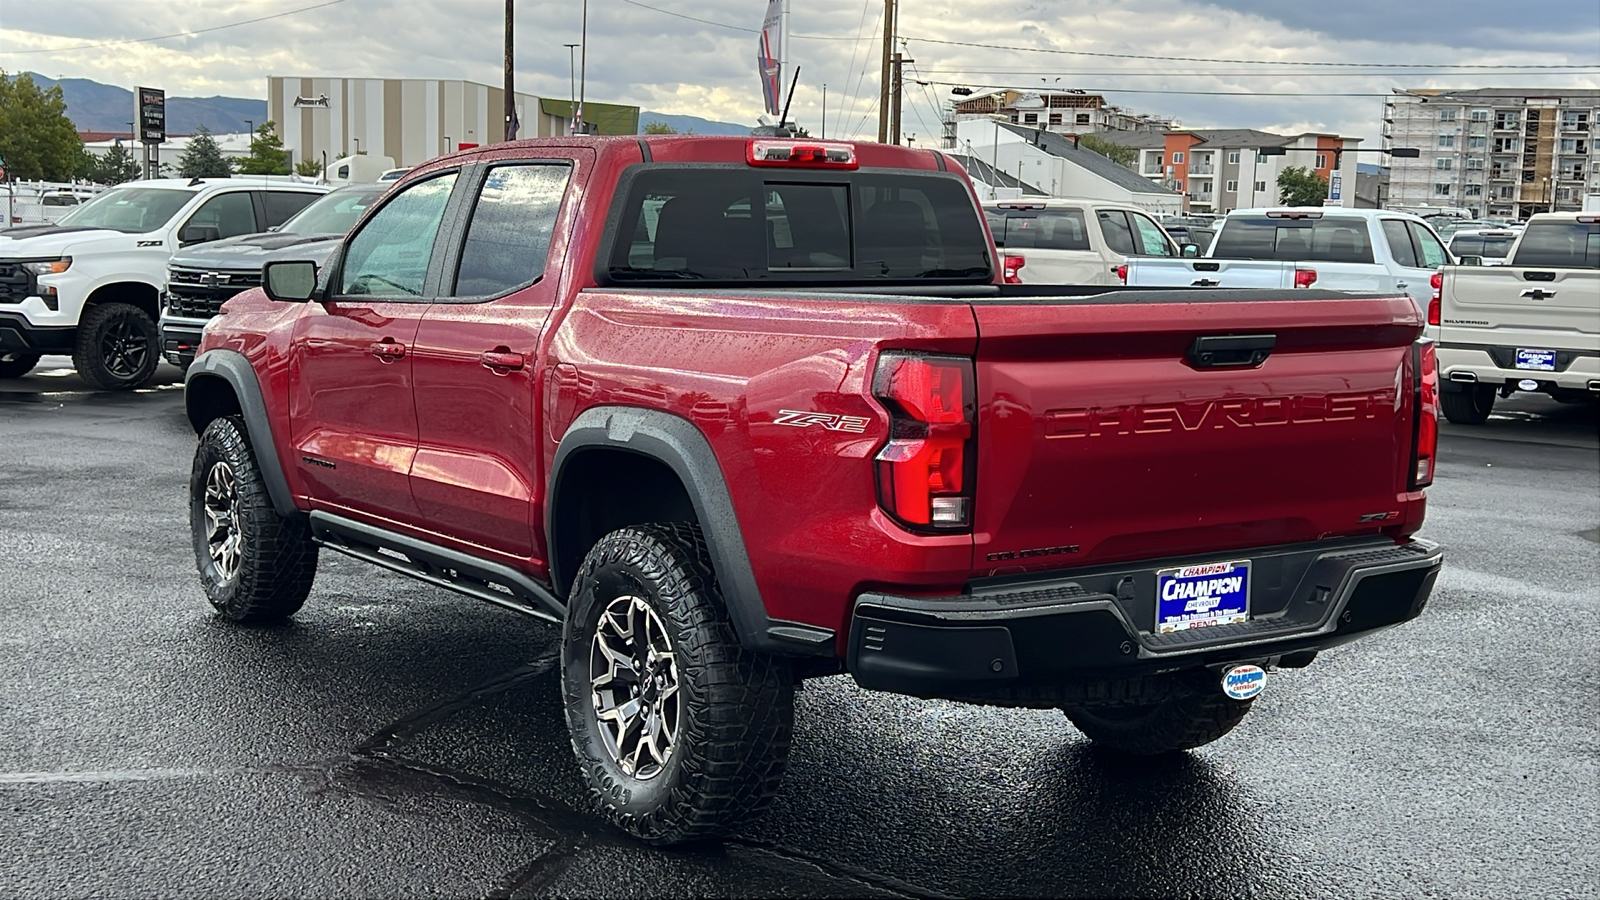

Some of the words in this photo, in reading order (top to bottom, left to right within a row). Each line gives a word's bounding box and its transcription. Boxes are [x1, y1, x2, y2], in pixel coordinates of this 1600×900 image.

[772, 408, 871, 434] ZR2
[1044, 395, 1386, 439] CHEVROLET
[1183, 565, 1227, 577] CHAMPION
[1162, 576, 1243, 601] CHAMPION
[1187, 599, 1219, 609] CHEVROLET
